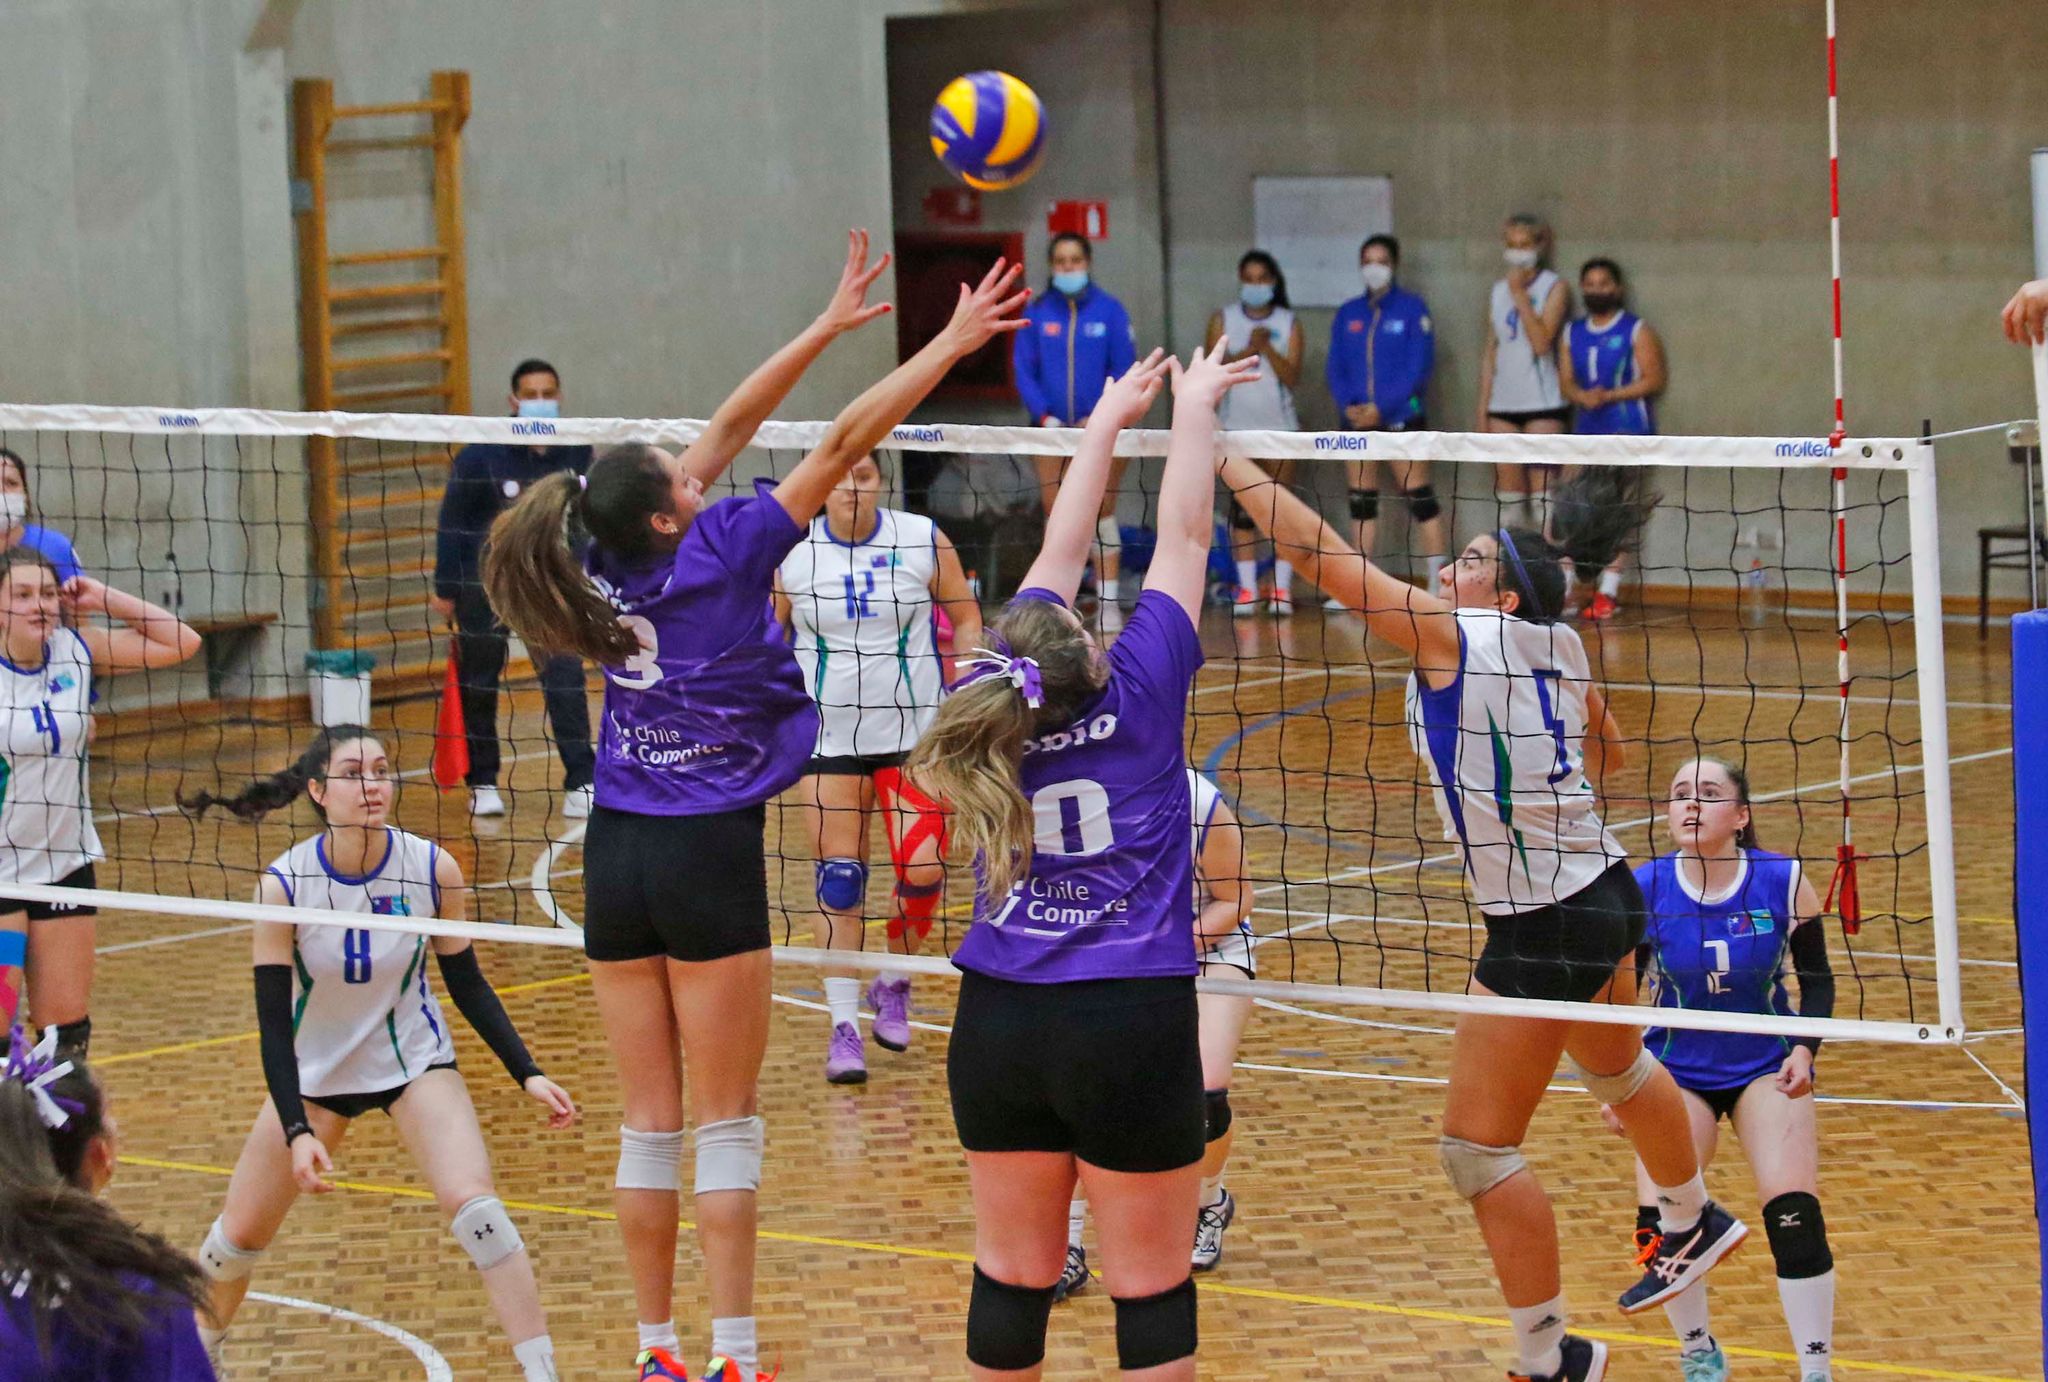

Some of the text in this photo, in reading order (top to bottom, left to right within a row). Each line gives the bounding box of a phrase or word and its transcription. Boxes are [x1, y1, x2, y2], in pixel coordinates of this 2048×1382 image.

[1588, 346, 1599, 383] 1
[511, 420, 557, 436] molten
[893, 428, 944, 443] molten
[1315, 435, 1367, 450] molten
[1775, 441, 1834, 457] molten
[840, 570, 879, 619] 12
[31, 701, 61, 755] 4
[635, 725, 682, 744] Chile
[1532, 668, 1572, 784] 5
[1031, 778, 1115, 857] 0
[1029, 876, 1091, 901] Chile
[344, 927, 372, 985] 8
